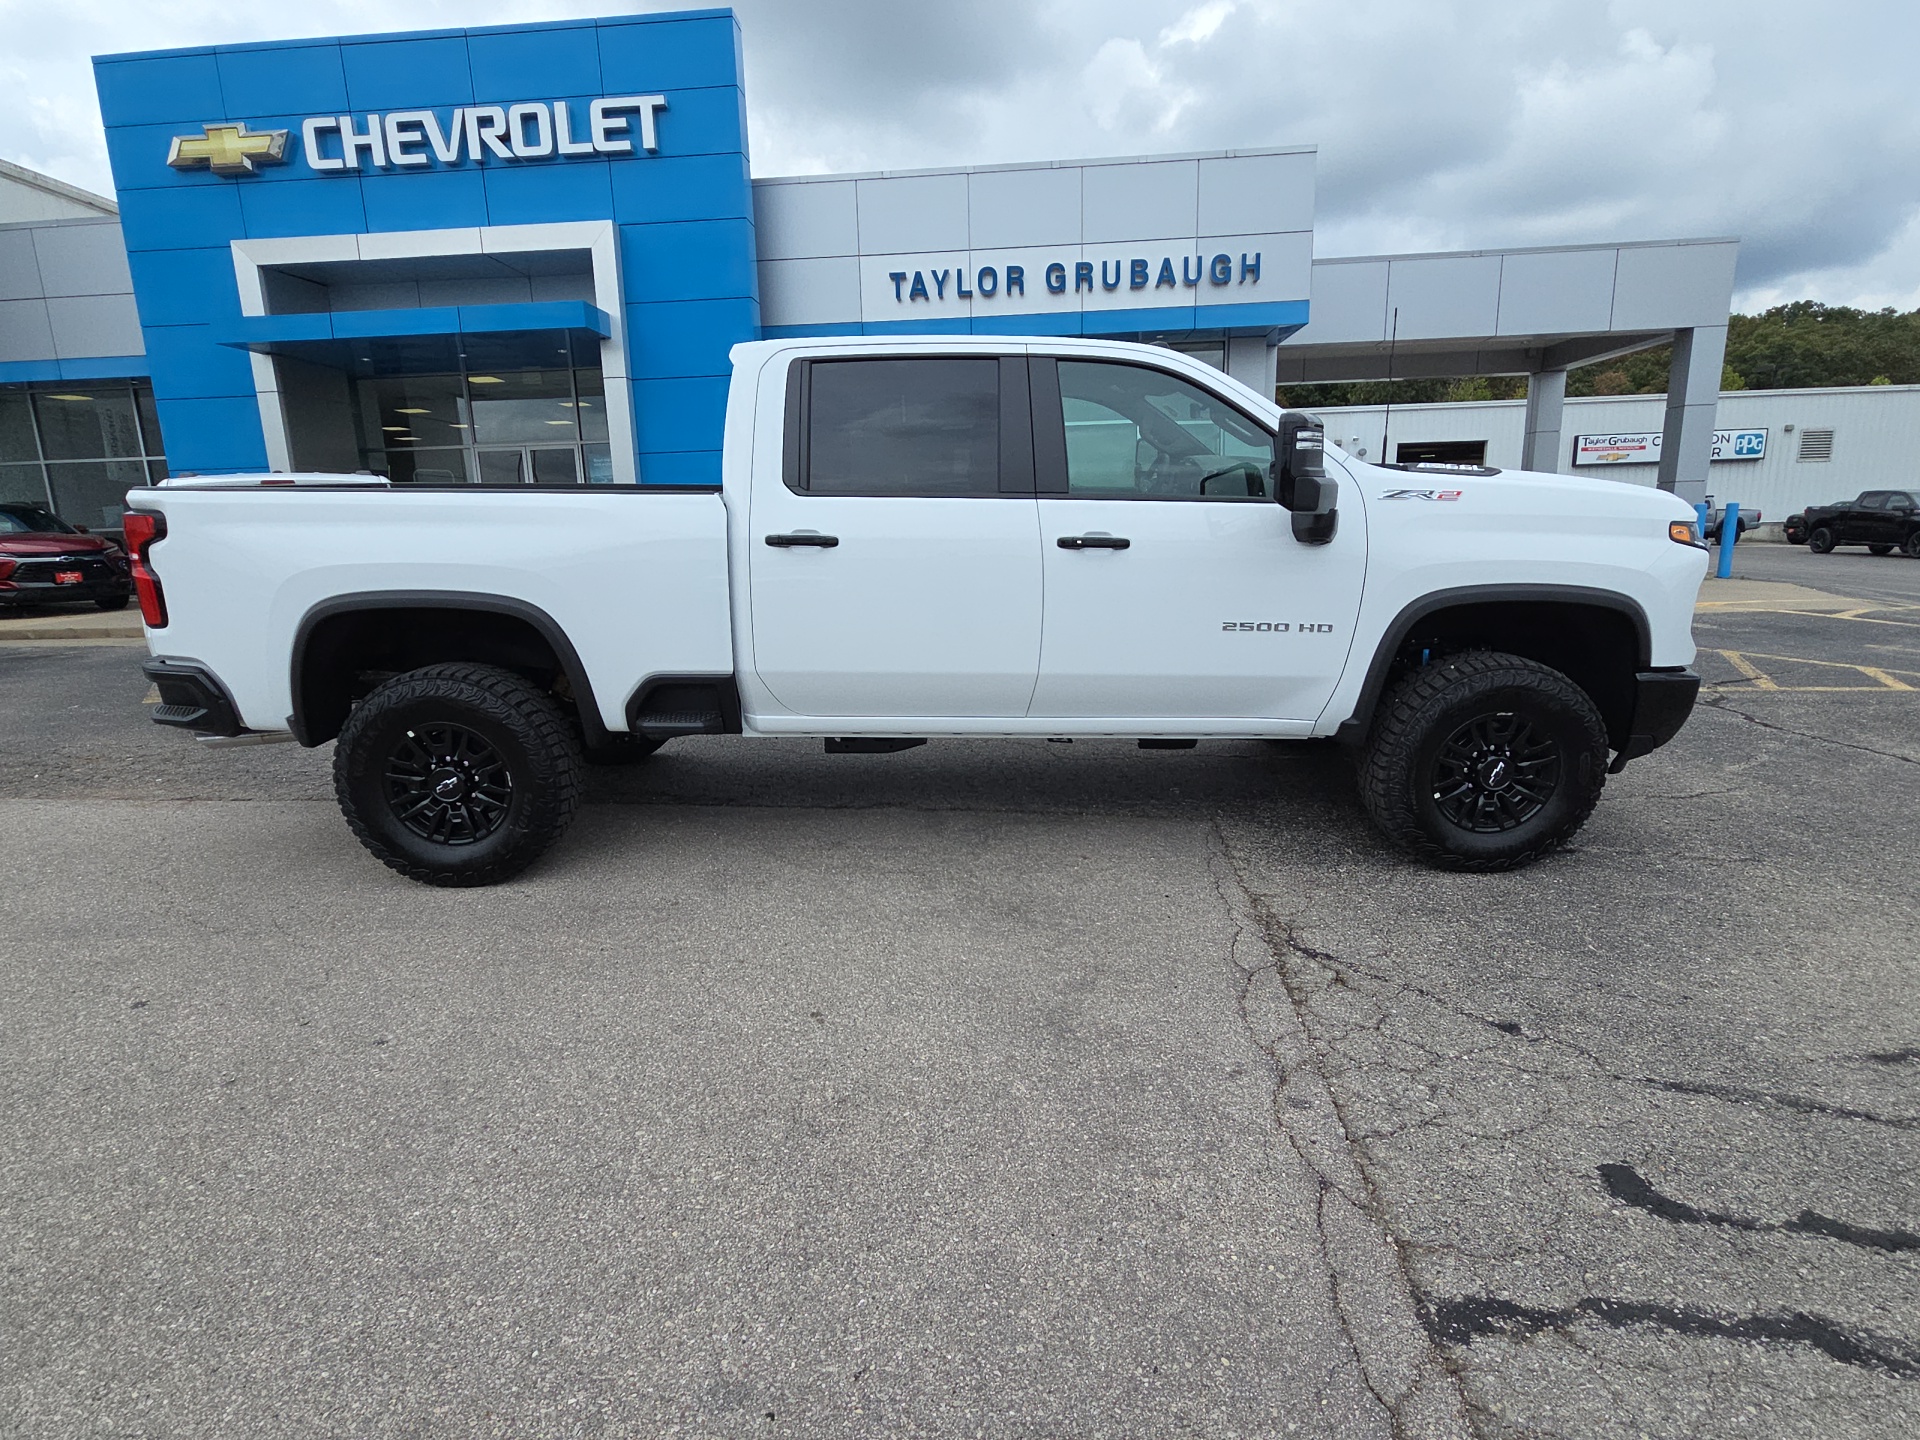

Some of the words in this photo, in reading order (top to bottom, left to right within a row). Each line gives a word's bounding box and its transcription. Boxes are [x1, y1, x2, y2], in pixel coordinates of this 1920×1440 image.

[302, 94, 668, 171] CHEVROLET
[889, 265, 1025, 300] TAYLOR
[1045, 252, 1262, 293] GRUBAUGH
[1582, 437, 1607, 447] Taylor
[1608, 436, 1648, 446] Grubaugh
[1735, 435, 1763, 454] PPG
[1377, 488, 1463, 501] ZR2
[1222, 621, 1290, 632] 2500
[1299, 623, 1334, 633] HD
